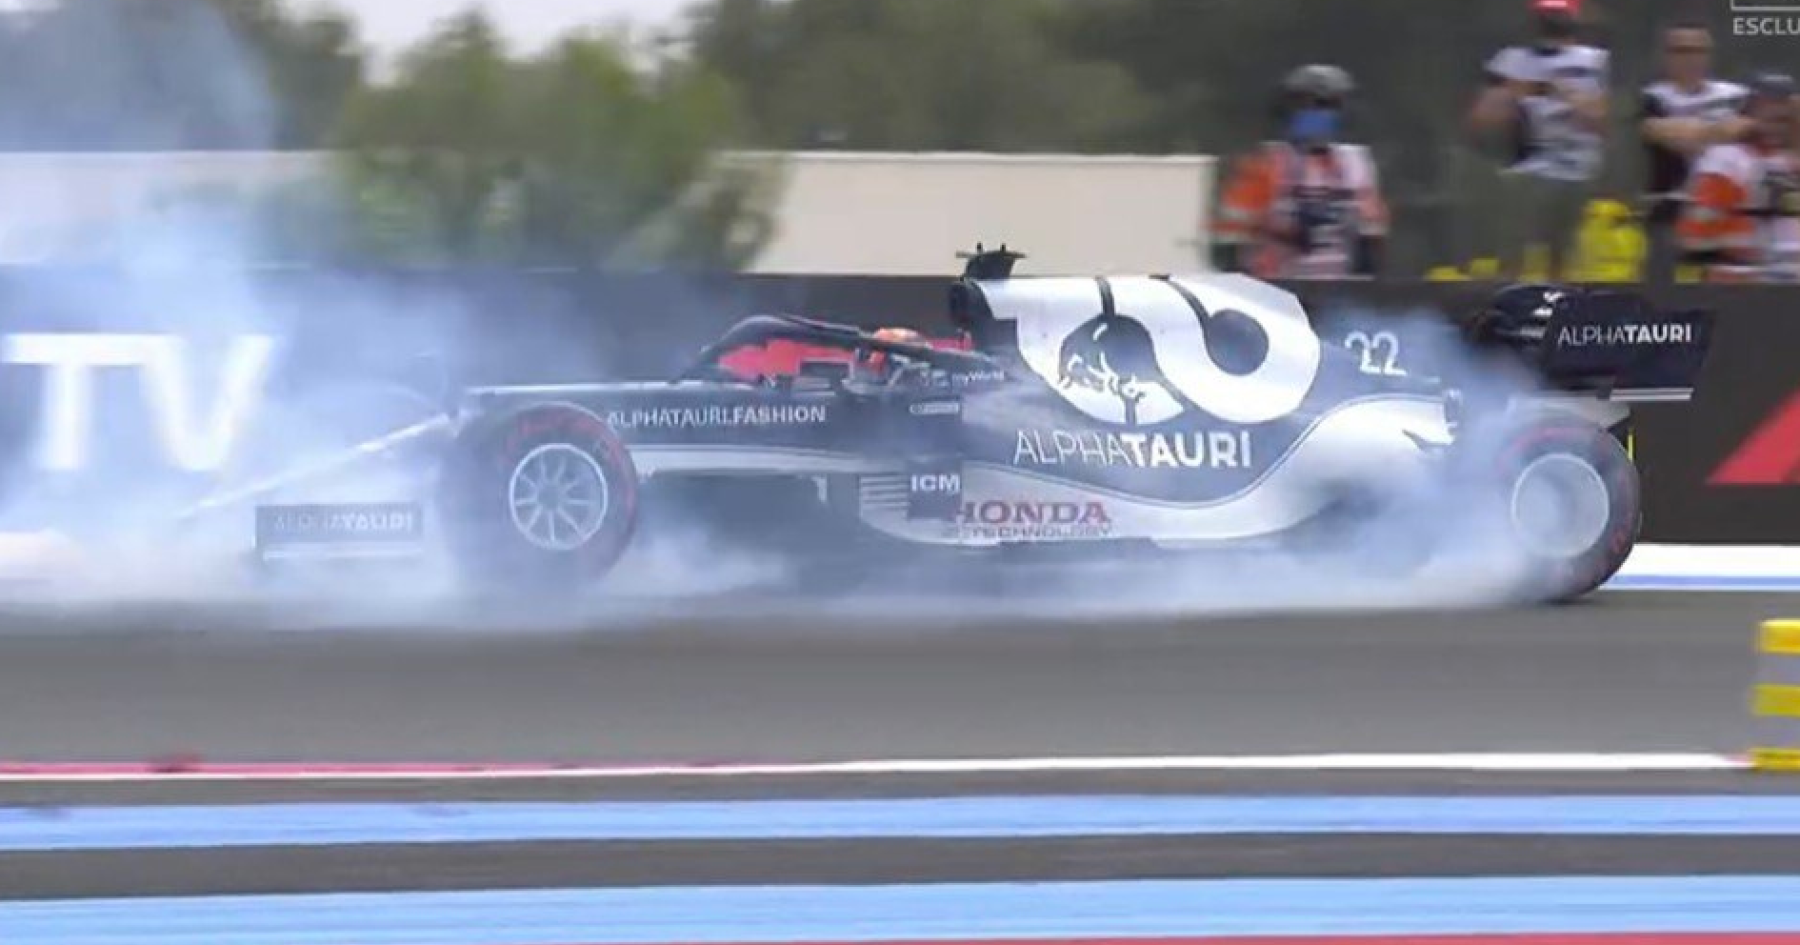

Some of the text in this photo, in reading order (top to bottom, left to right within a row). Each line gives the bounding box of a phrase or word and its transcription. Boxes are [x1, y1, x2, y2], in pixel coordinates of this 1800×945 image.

[1557, 322, 1692, 347] ALPHATAURI
[1344, 329, 1407, 376] 22
[3, 332, 276, 471] TV
[1013, 428, 1252, 469] ALPHATAURI
[910, 474, 961, 493] ICM
[955, 500, 1112, 525] HONDA
